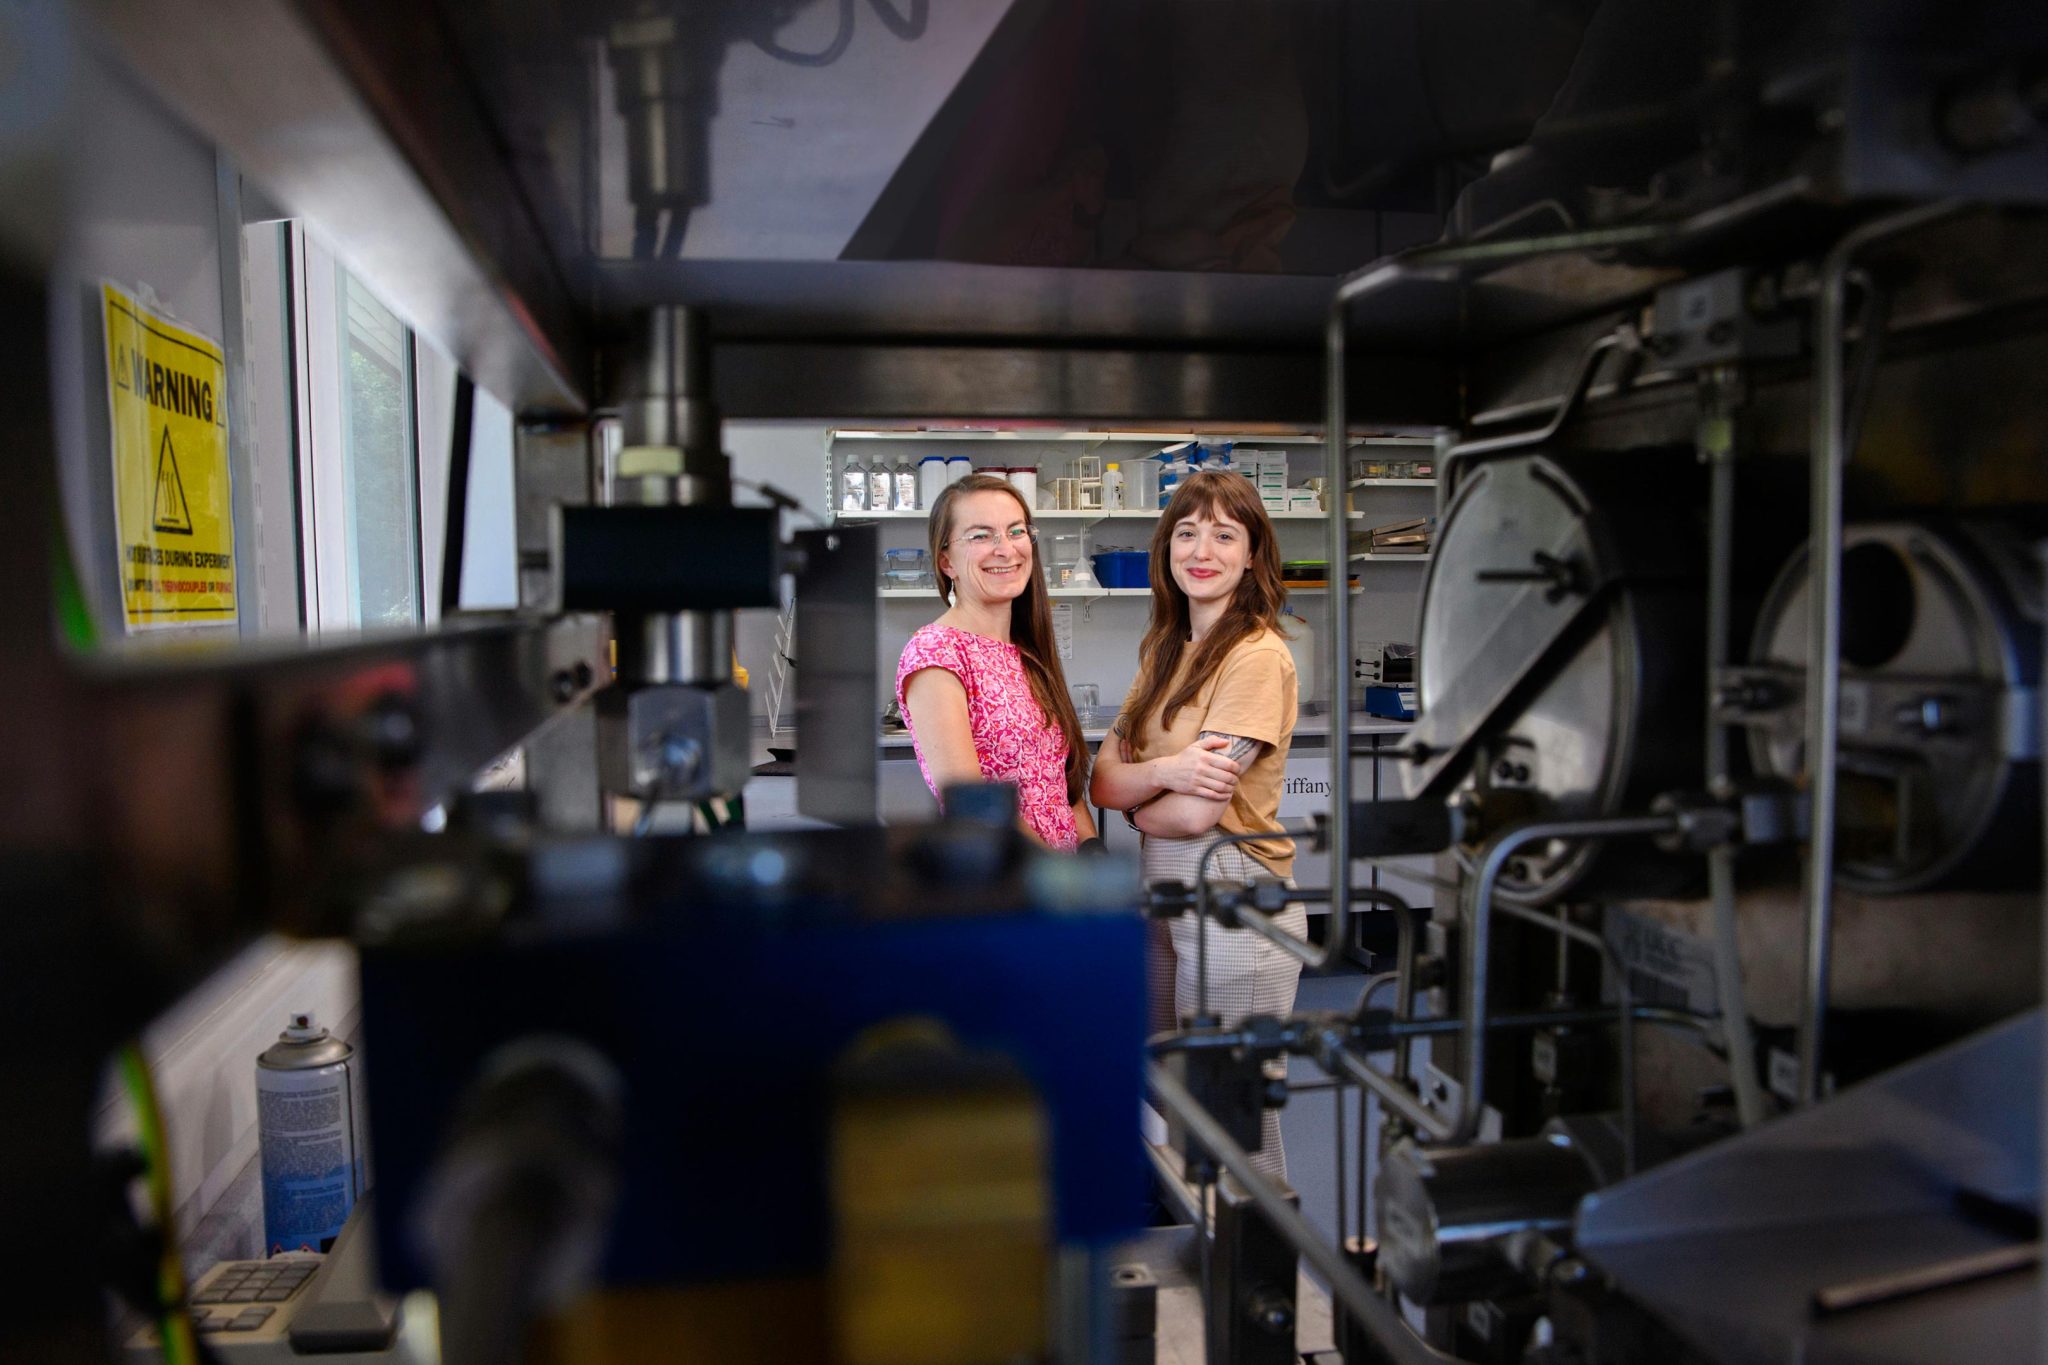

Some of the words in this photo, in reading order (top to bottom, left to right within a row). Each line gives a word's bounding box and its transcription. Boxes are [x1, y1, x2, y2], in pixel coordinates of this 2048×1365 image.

[131, 348, 213, 424] WARNING
[164, 549, 193, 568] DURING
[1283, 777, 1332, 798] iffany
